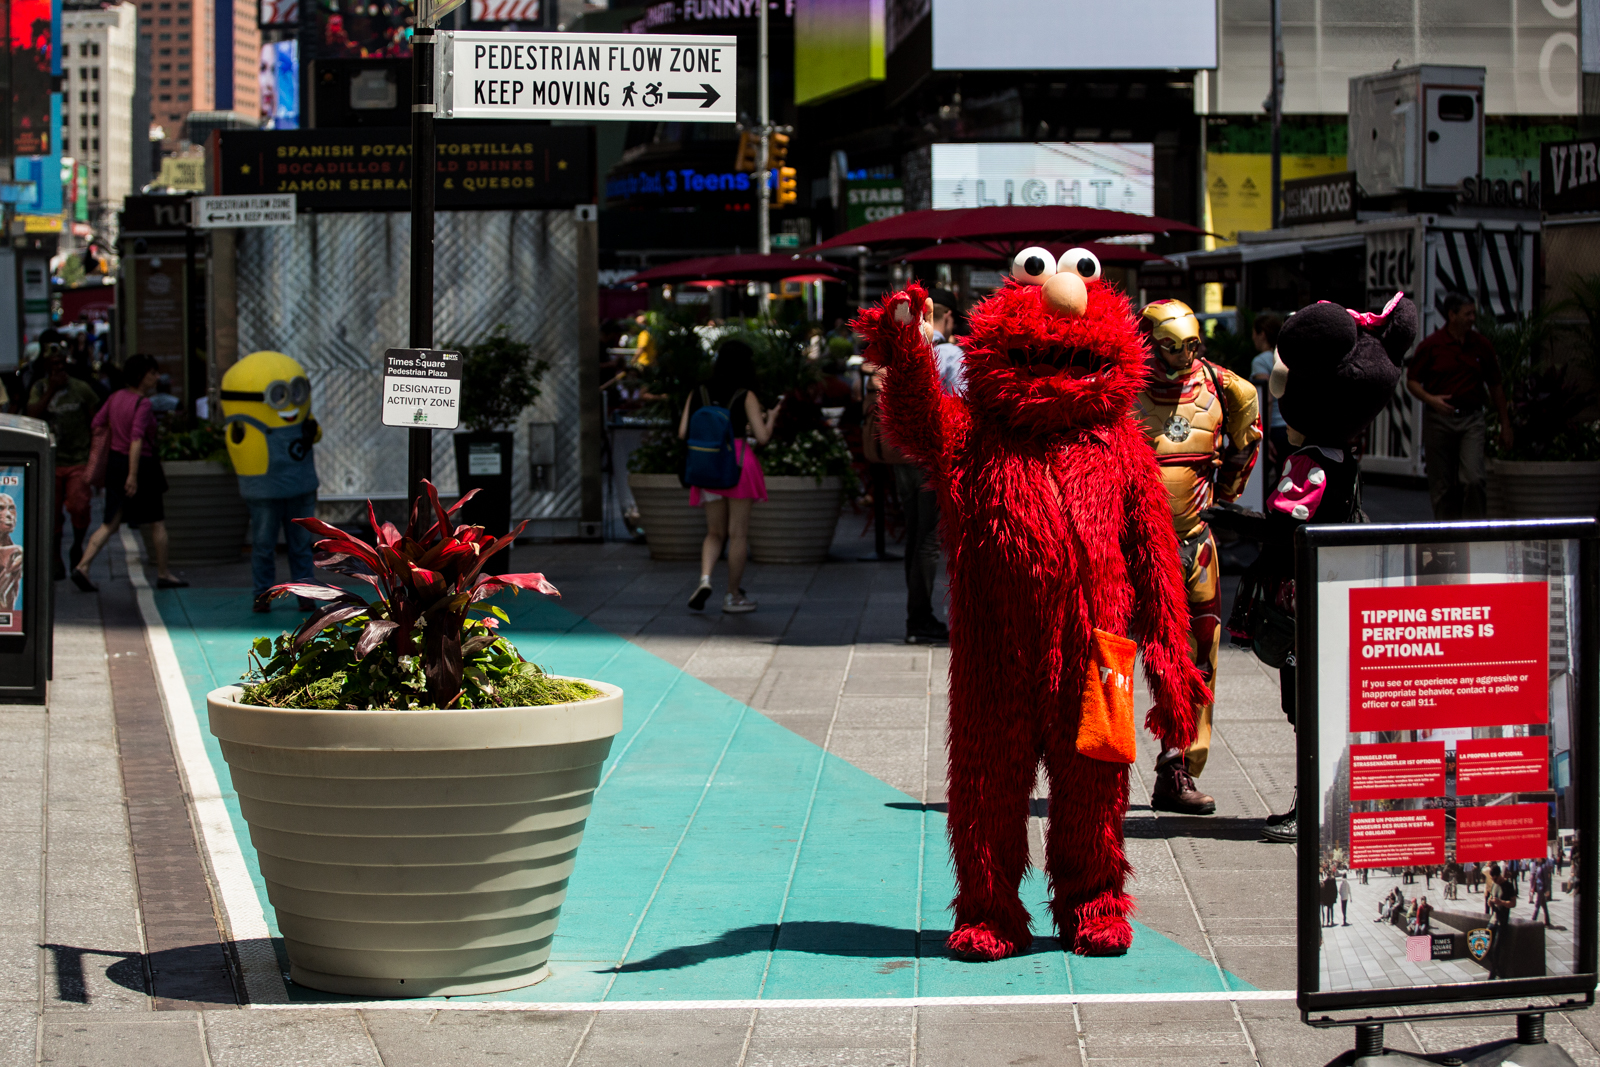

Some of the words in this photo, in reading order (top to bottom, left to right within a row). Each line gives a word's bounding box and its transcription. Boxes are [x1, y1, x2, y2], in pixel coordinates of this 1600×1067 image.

[475, 45, 600, 70] PEDESTRIAN
[609, 47, 662, 72] FLOW
[670, 48, 722, 73] ZONE
[474, 80, 524, 105] KEEP
[532, 81, 610, 106] MOVING
[277, 145, 354, 157] SPANISH
[437, 143, 534, 155] TORTILLAS
[277, 161, 391, 174] BOCADILLOS
[466, 160, 534, 171] DRINKS
[1549, 142, 1600, 195] VIR
[277, 177, 341, 191] JAMÓN
[443, 177, 454, 189] &
[462, 176, 535, 192] QUESOS
[665, 169, 678, 192] 3
[680, 168, 750, 192] Teens
[975, 179, 1113, 208] LIGHT
[1300, 185, 1320, 216] HOT
[1321, 181, 1351, 214] DOGS
[206, 200, 249, 210] PEDESTRIAN
[251, 199, 270, 209] FLOW
[272, 198, 291, 208] ZONE
[245, 211, 261, 221] KEEP
[263, 211, 291, 220] MOVING
[388, 357, 414, 366] Times
[416, 358, 446, 368] Square
[387, 367, 426, 376] Pedestrian
[428, 369, 448, 377] Plaza
[393, 384, 452, 394] DESIGNATED
[387, 396, 428, 406] ACTIVITY
[430, 398, 456, 408] ZONE
[1361, 608, 1427, 624] TIPPING
[1431, 606, 1491, 622] STREET
[1362, 624, 1474, 642] PERFORMERS
[1478, 623, 1495, 638] IS
[1361, 642, 1444, 658] OPTIONAL
[1099, 666, 1131, 692] TIPS
[1362, 680, 1368, 688] If
[1370, 680, 1385, 690] you
[1387, 679, 1402, 687] see
[1403, 679, 1413, 687] or
[1414, 677, 1458, 687] experience
[1460, 677, 1475, 685] any
[1476, 674, 1518, 685] aggressive
[1519, 674, 1529, 682] or
[1362, 689, 1417, 699] inappropriate
[1418, 687, 1455, 696] behavior,
[1456, 686, 1487, 695] contact
[1495, 684, 1519, 694] police
[1362, 700, 1389, 709] officer
[1401, 699, 1416, 707] call
[1417, 698, 1437, 706] 911.
